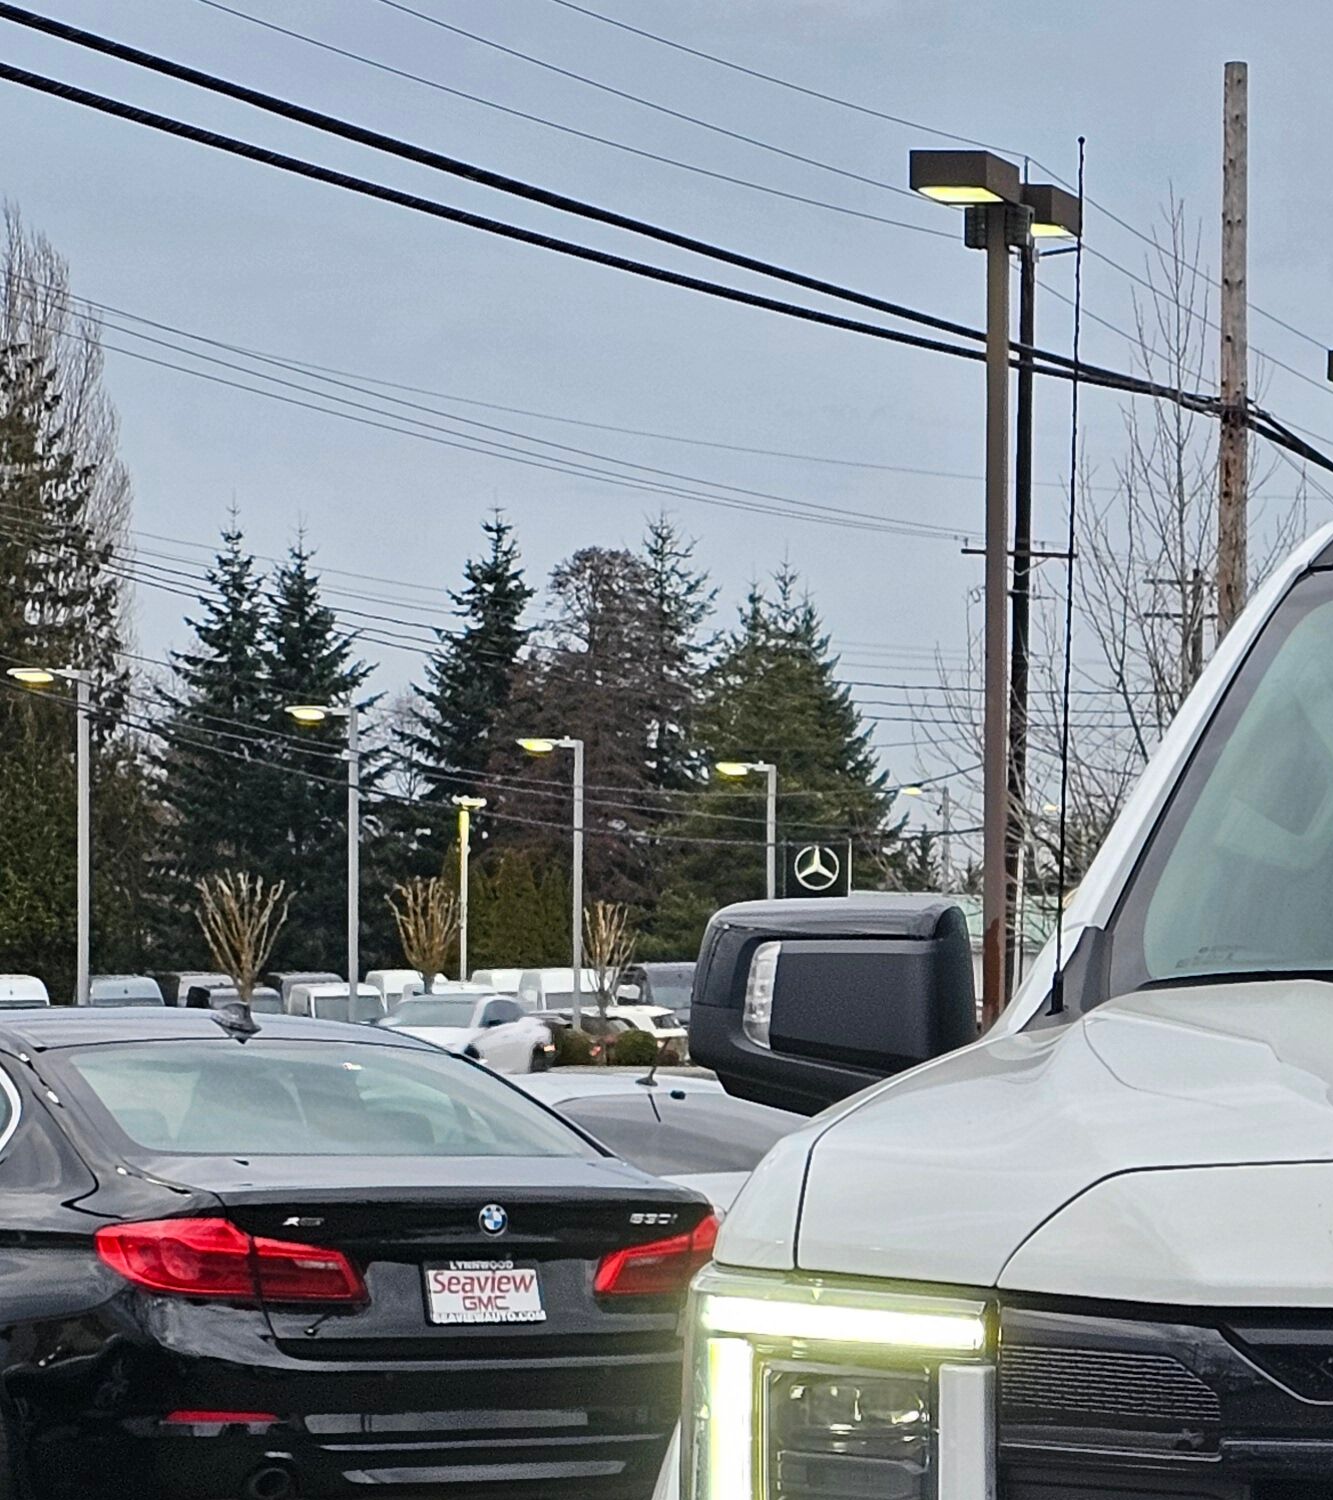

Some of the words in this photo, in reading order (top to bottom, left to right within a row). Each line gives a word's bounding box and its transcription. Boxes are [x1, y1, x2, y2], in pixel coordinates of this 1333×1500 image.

[449, 1260, 514, 1270] LYNNWOOD
[432, 1270, 535, 1294] Seaview
[462, 1295, 511, 1311] GMC
